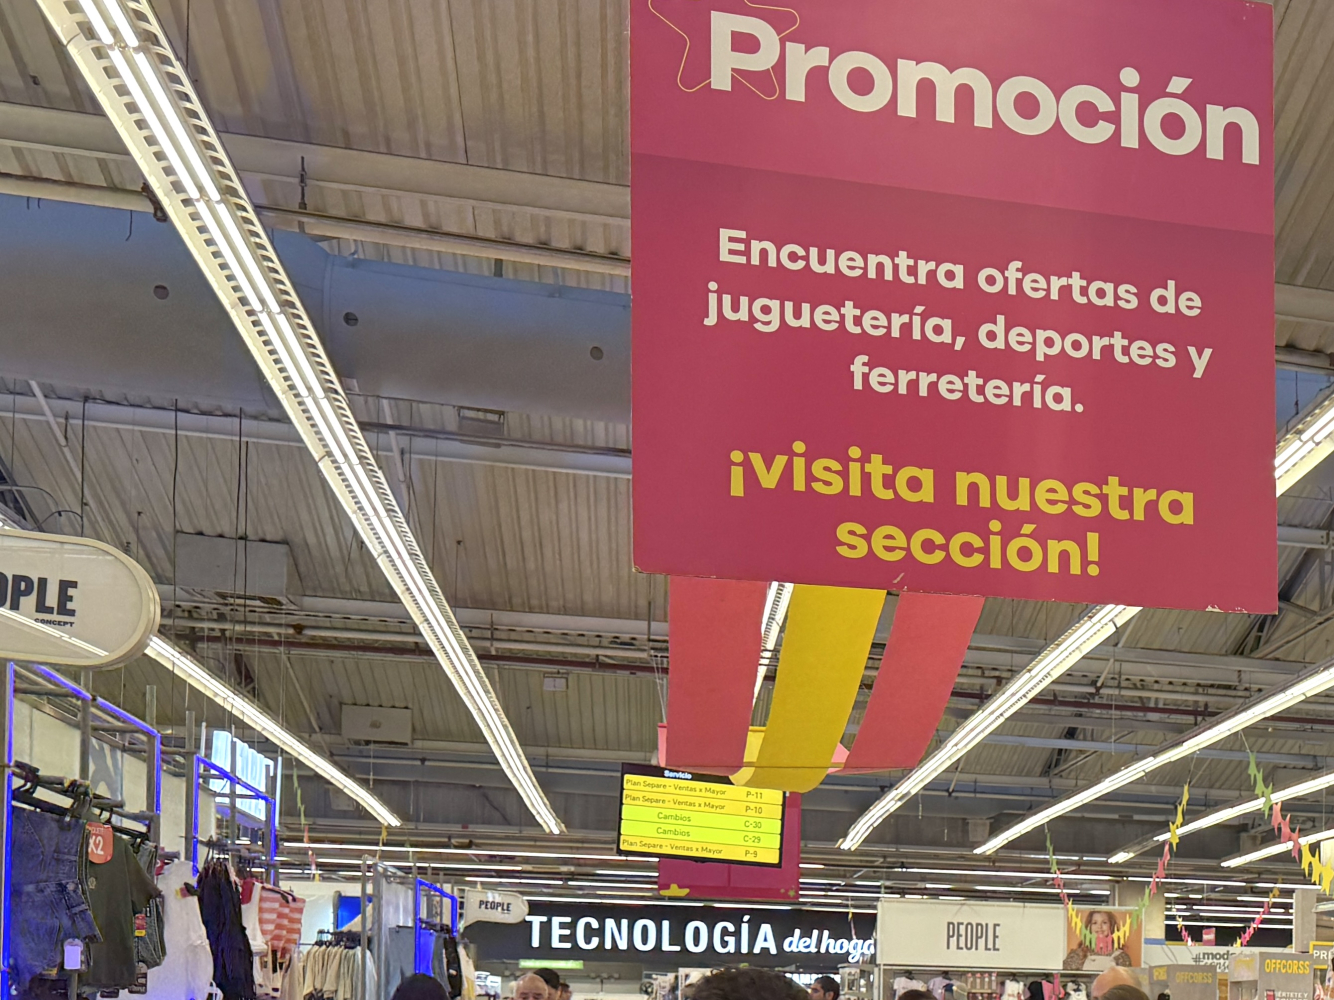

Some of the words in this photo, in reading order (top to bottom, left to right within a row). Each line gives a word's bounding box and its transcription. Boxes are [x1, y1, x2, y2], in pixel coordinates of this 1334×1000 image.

[711, 11, 1260, 164] Promoción
[718, 228, 964, 289] Encuentra
[977, 261, 1139, 309] ofertas
[1149, 280, 1203, 317] de
[704, 282, 966, 350] juguetería,
[978, 315, 1177, 367] deportes
[1187, 345, 1213, 378] y
[850, 355, 1085, 412] ferretería.
[730, 441, 935, 503] ¡visita
[955, 472, 1195, 525] nuestra
[835, 519, 1101, 577] sección!
[664, 770, 693, 779] Servicio
[625, 779, 641, 787] Plan
[642, 780, 667, 790] Separe
[674, 784, 697, 793] Ventas
[704, 787, 727, 796] Mayor
[746, 791, 763, 799] P-11
[625, 793, 641, 802] Plan
[641, 795, 667, 805] Separe
[673, 798, 696, 808] Ventas
[704, 802, 726, 811] Mayor
[745, 806, 763, 815] P-10
[657, 811, 692, 823] Cambios
[744, 820, 762, 829] C-30
[88, 835, 104, 855] X2
[656, 827, 691, 838] Cambios
[743, 835, 761, 844] C-29
[622, 839, 638, 848] Plan
[639, 840, 664, 850] Separe
[669, 843, 694, 853] Ventas
[701, 847, 724, 856] Mayor
[744, 850, 758, 858] P-9
[478, 899, 512, 912] PEOPLE
[525, 915, 778, 955] TECNOLOGÍA
[783, 928, 820, 953] del
[946, 921, 1000, 952] PEOPLE
[1265, 959, 1310, 974] OFFCORSS
